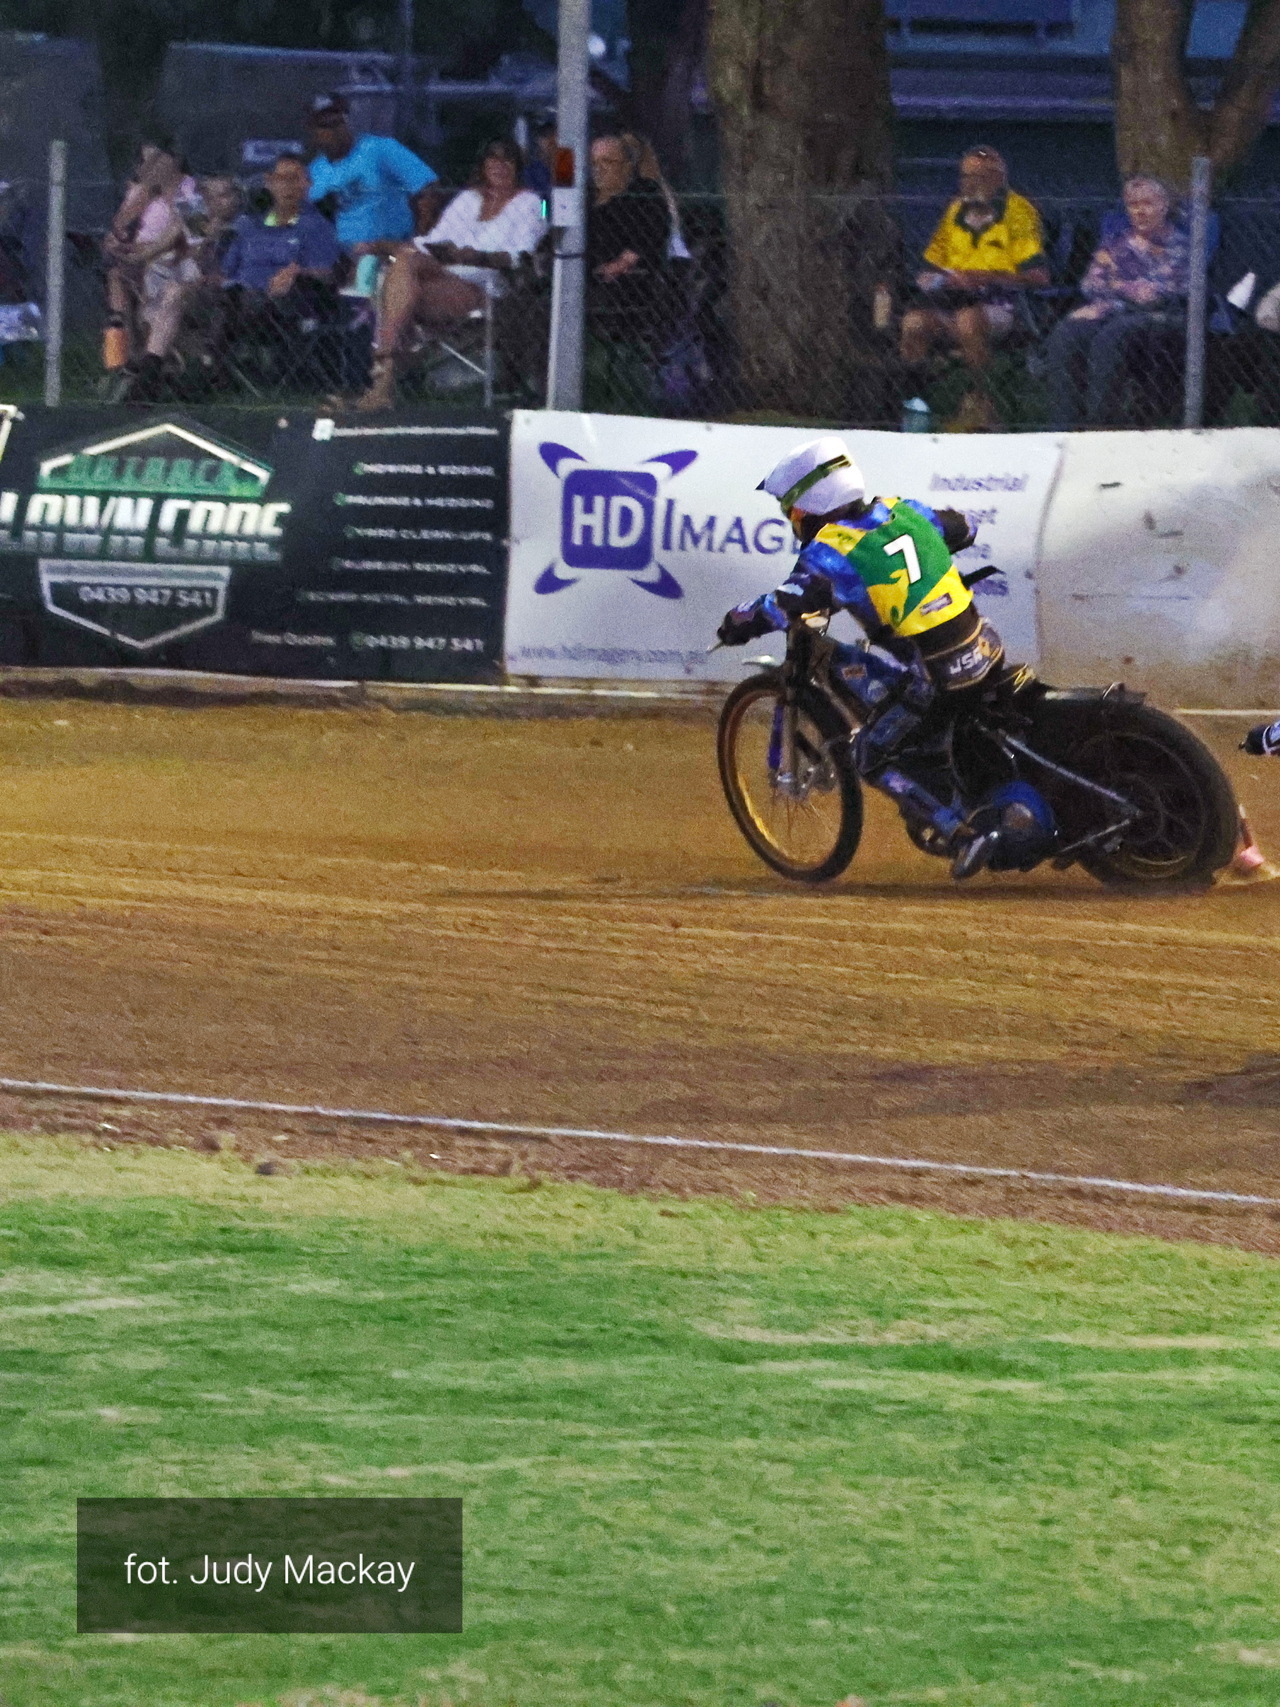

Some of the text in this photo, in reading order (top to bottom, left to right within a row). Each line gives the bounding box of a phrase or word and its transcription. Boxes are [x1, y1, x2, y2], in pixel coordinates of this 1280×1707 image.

[929, 473, 1029, 491] Industrial
[571, 494, 801, 554] HD IMAG
[883, 533, 922, 584] 7
